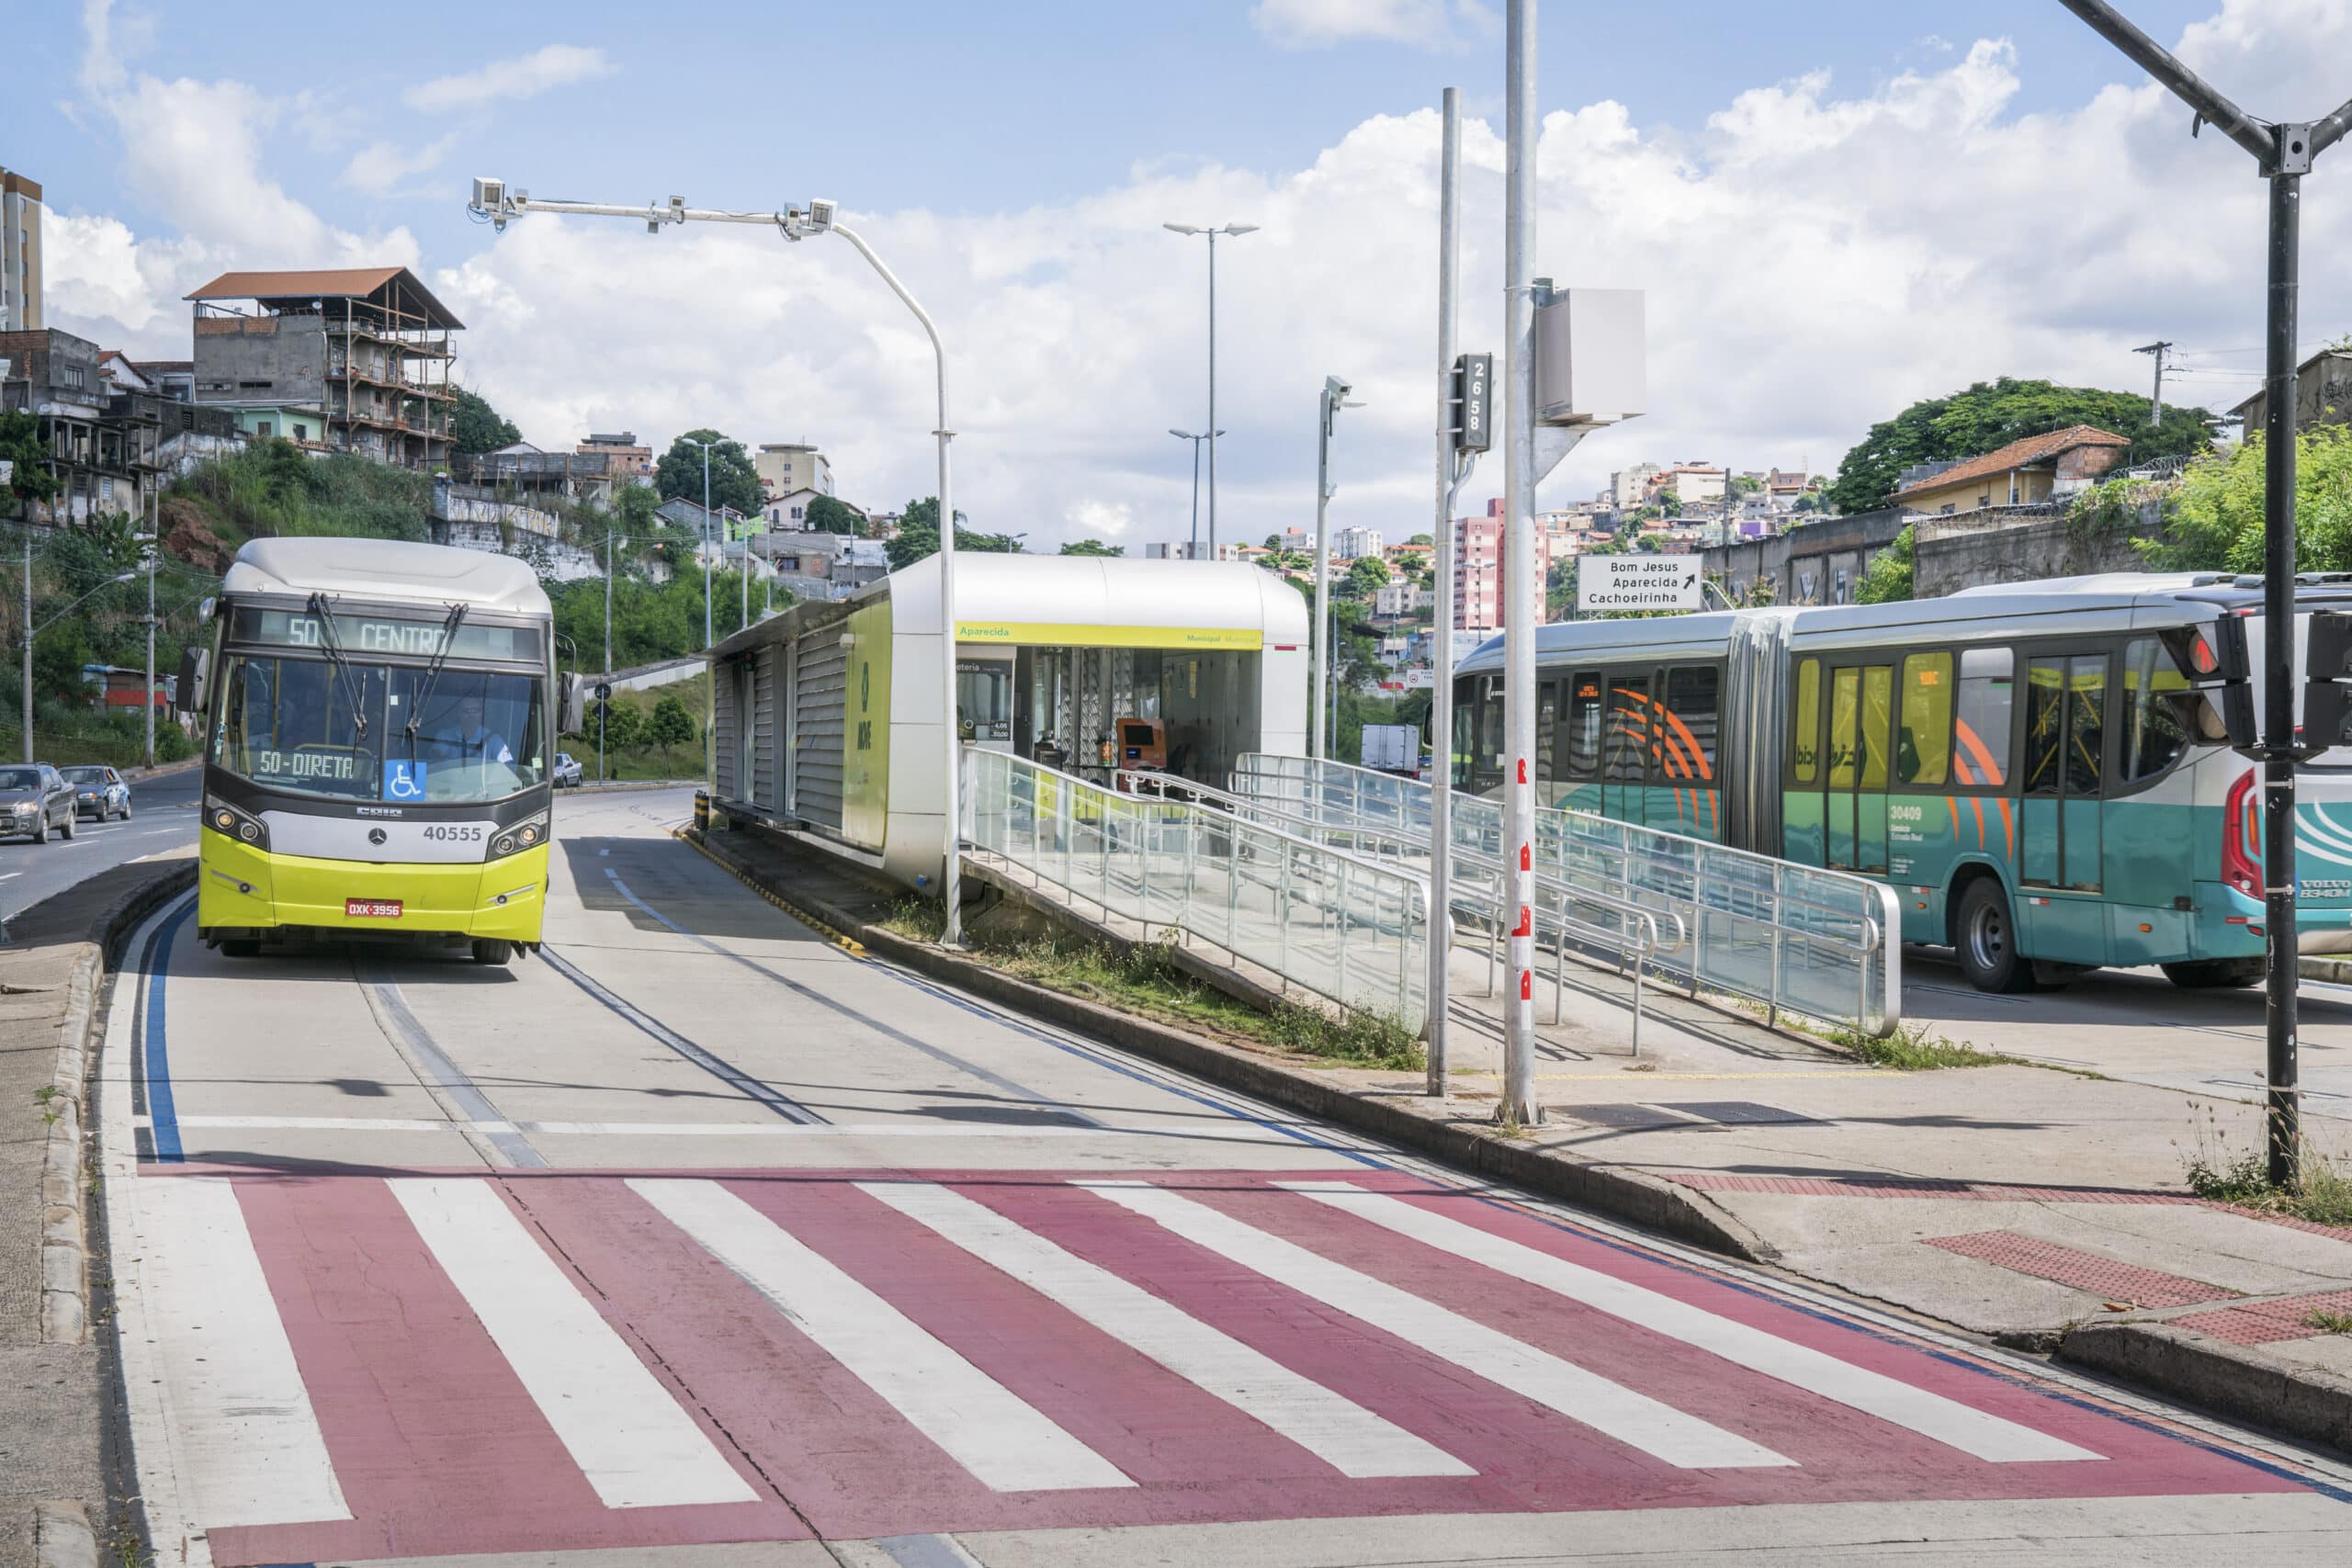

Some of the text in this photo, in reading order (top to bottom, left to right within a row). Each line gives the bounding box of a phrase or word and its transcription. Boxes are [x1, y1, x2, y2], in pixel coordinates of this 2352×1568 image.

[1611, 562, 1679, 572] Bom Jesus
[1612, 577, 1679, 590] Aparecida
[1589, 592, 1678, 604] Cachoeirinha
[289, 618, 319, 646] 50
[960, 626, 1009, 637] Aparecida
[956, 663, 979, 671] eteria
[1891, 806, 1922, 820] 30409
[424, 827, 481, 841] 40555
[2301, 880, 2351, 888] VOLVO
